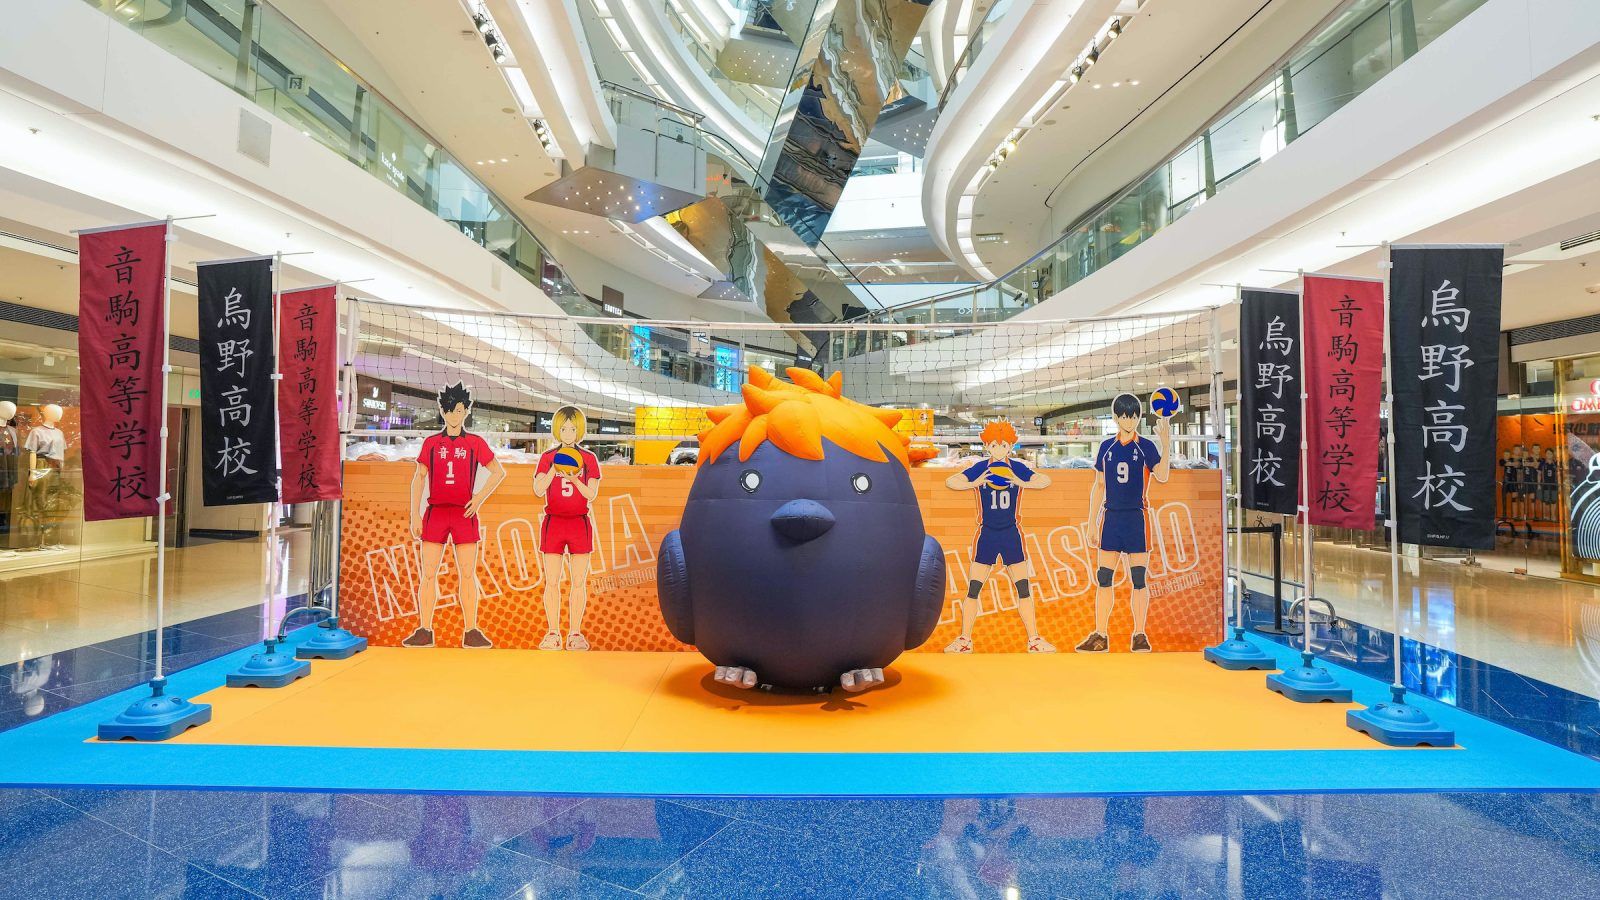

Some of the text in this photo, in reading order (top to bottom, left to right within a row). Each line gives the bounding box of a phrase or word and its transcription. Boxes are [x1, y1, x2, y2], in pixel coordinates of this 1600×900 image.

[104, 245, 153, 503] 音駒高等学校
[214, 286, 259, 479] 烏野高校
[292, 302, 320, 490] 音駒高等学校
[1248, 315, 1294, 489] 烏野高校
[1316, 294, 1364, 514] 音駒高等学校
[1410, 279, 1475, 513] 烏野高校
[1571, 398, 1600, 412] OM
[445, 461, 455, 478] 1
[561, 477, 574, 497] 5
[990, 490, 1010, 510] 10
[1116, 461, 1129, 484] 9
